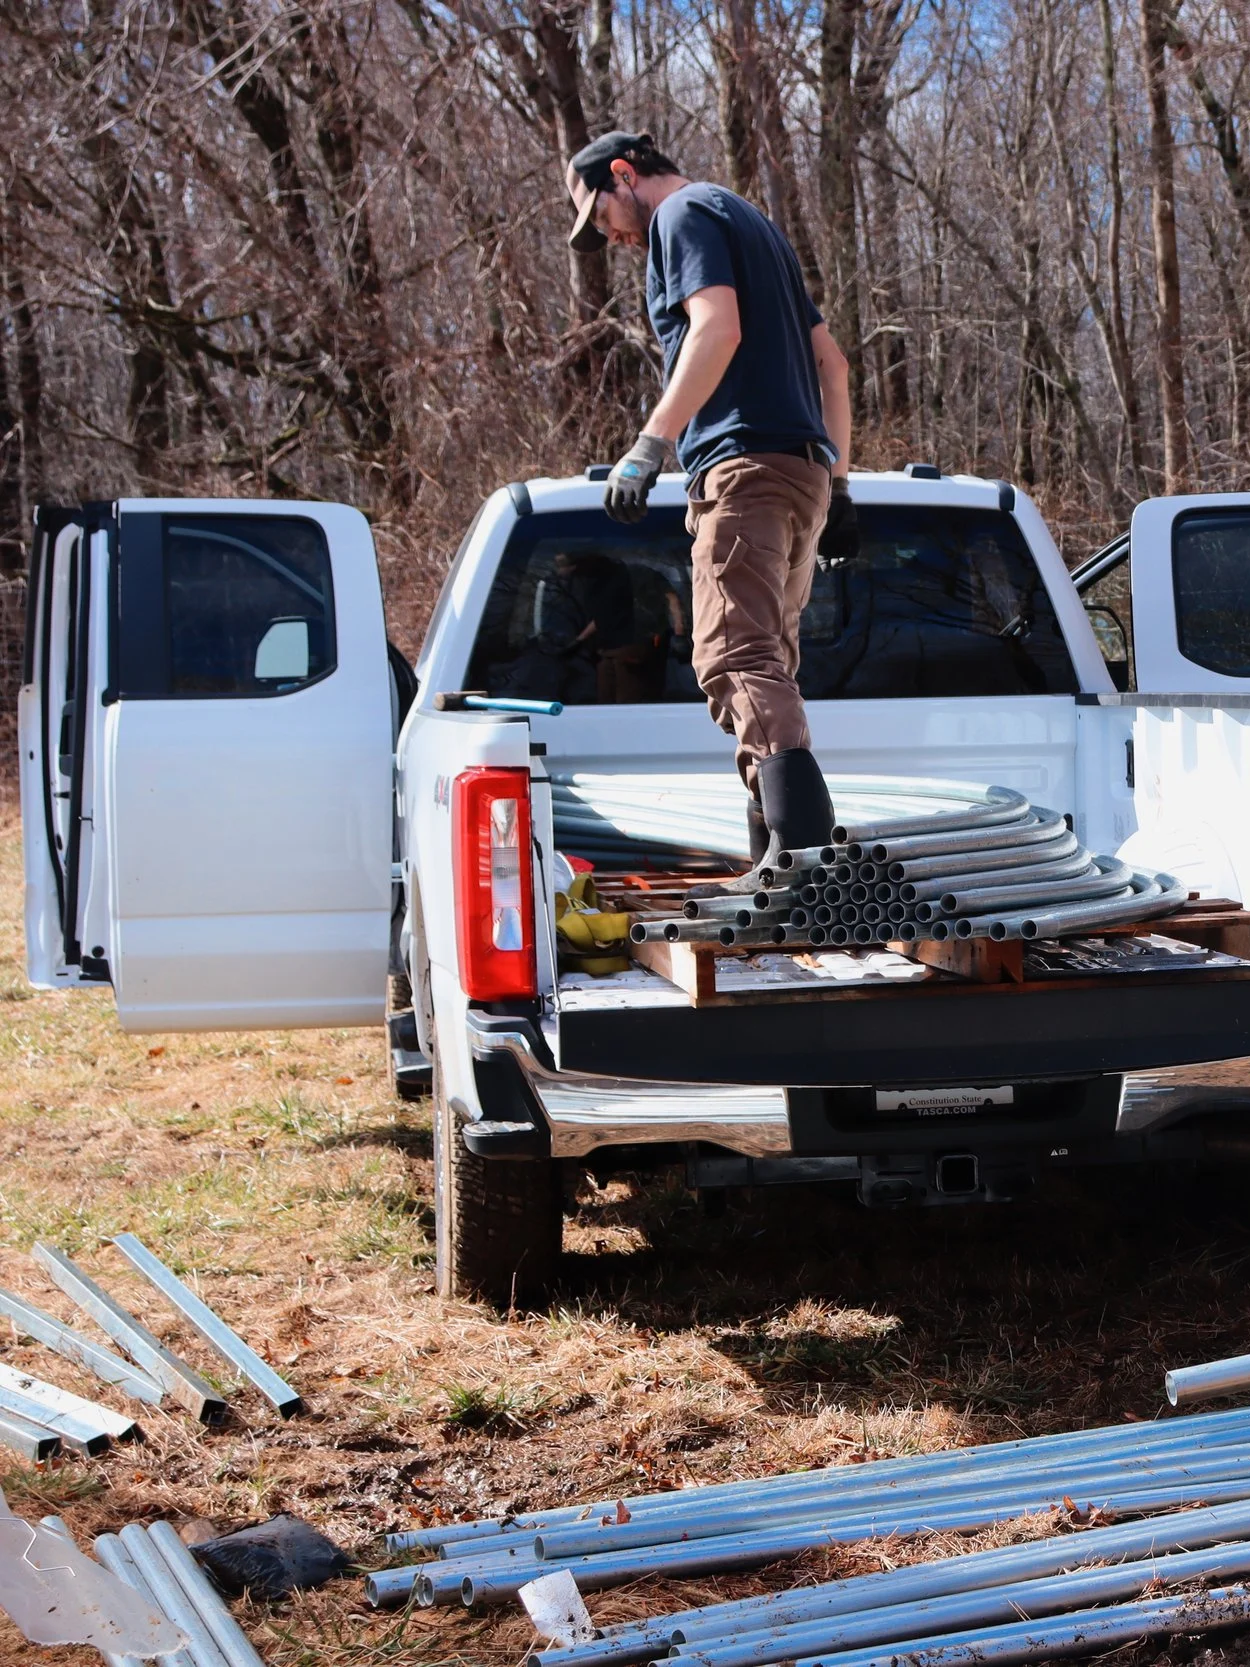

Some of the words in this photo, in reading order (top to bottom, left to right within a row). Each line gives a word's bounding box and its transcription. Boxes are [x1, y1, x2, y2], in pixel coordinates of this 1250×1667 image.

[909, 1096, 959, 1106] Constitution
[961, 1094, 982, 1103] State
[916, 1106, 976, 1116] TASCA.COM
